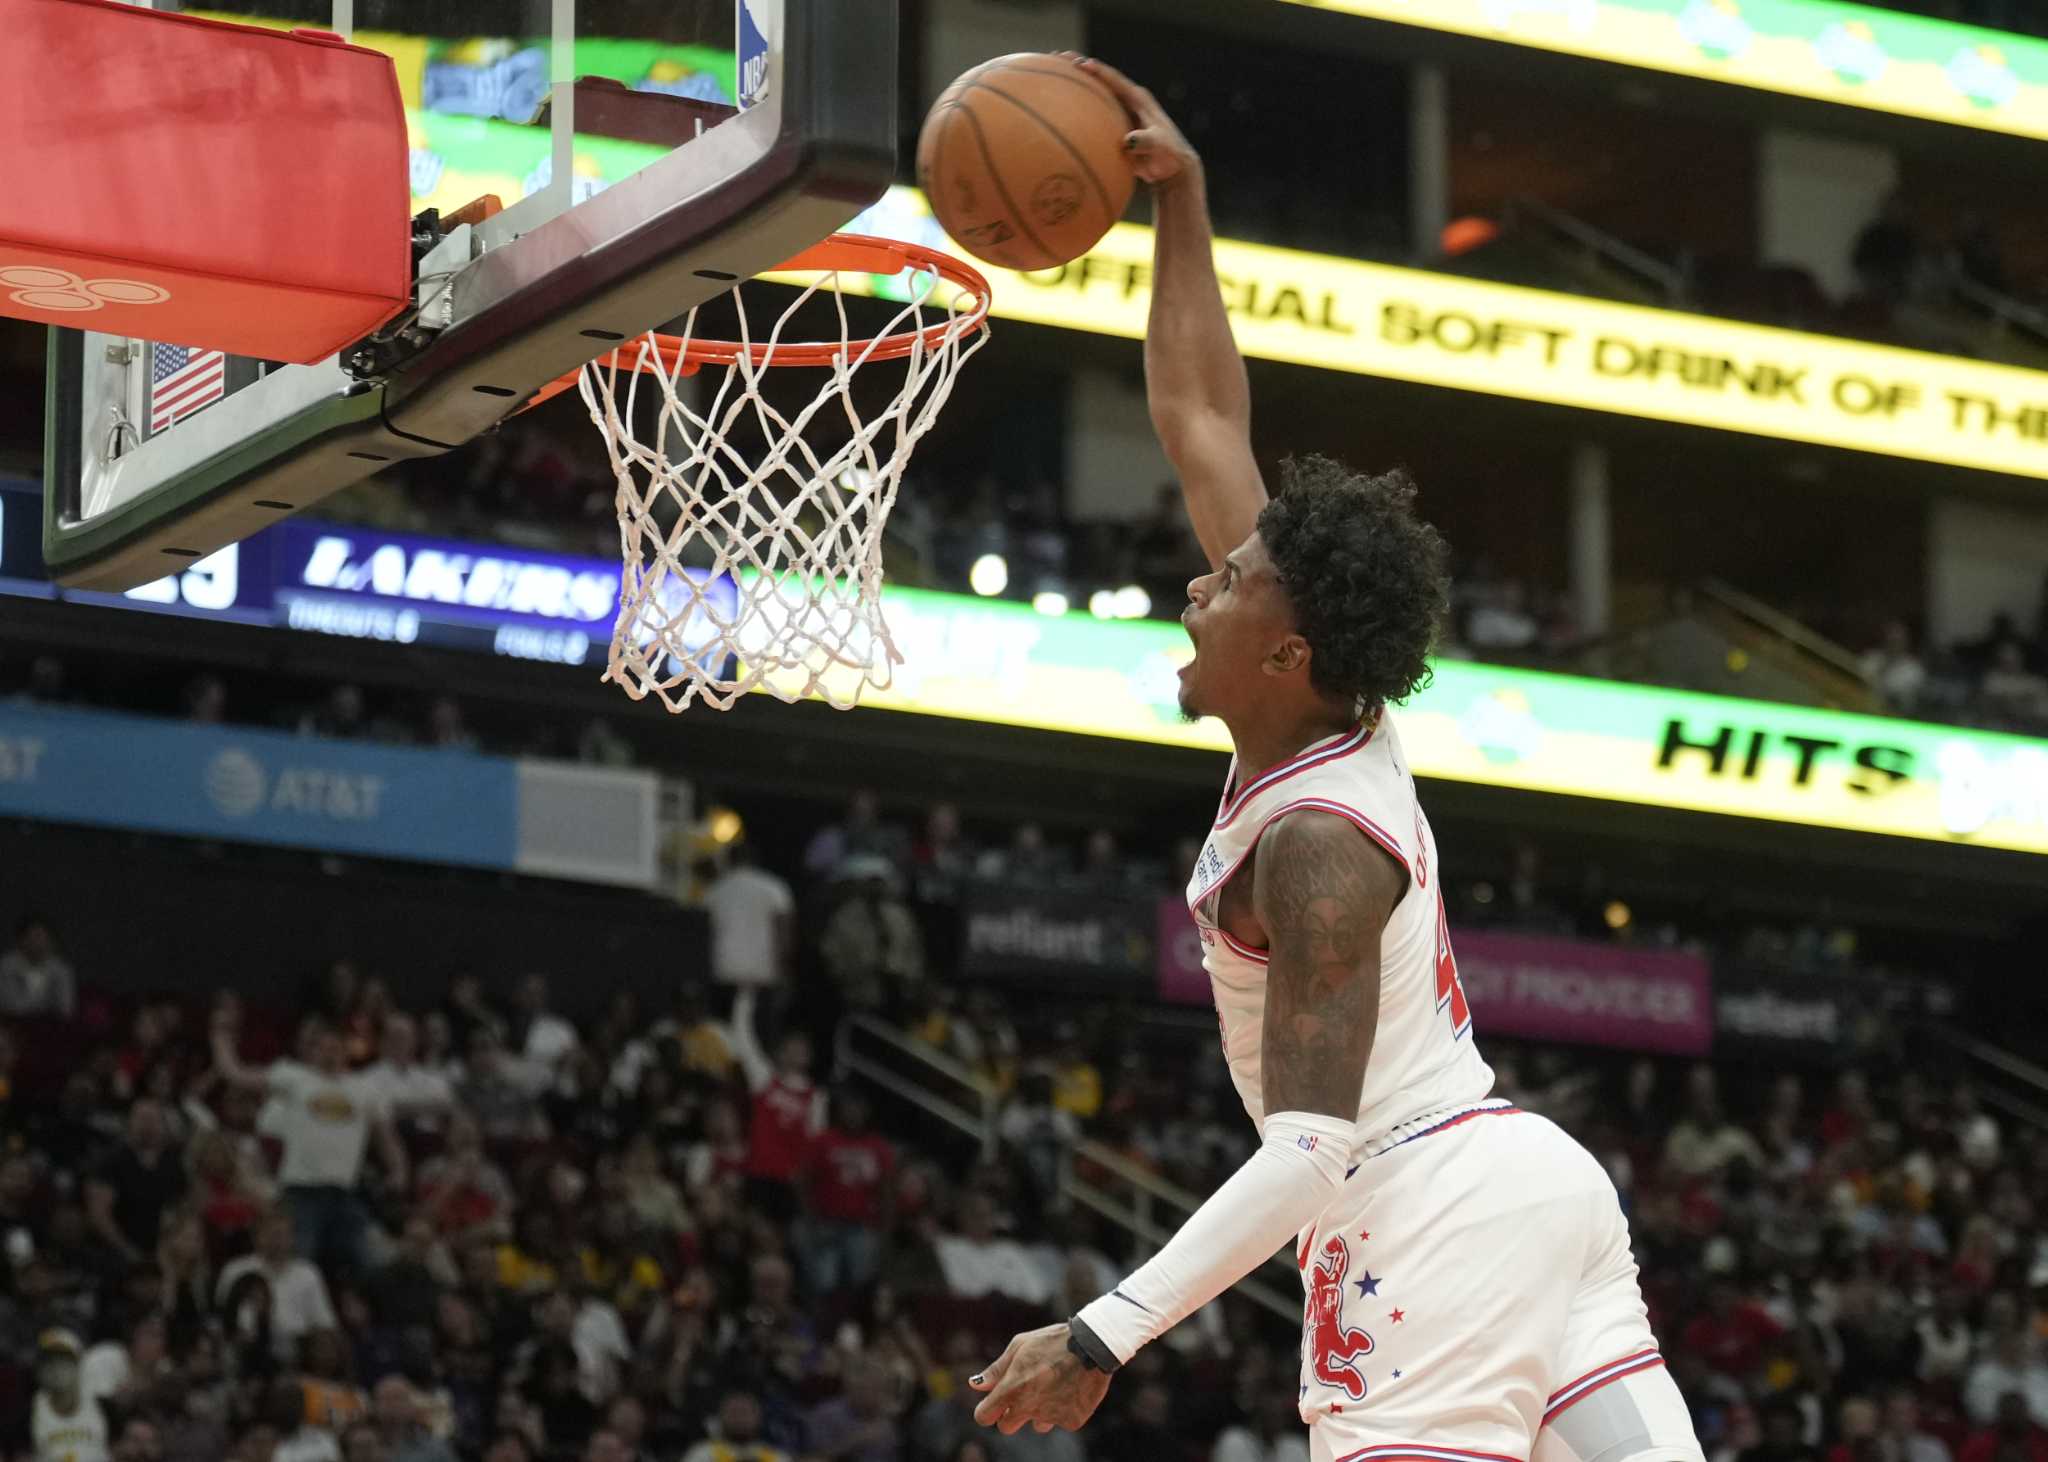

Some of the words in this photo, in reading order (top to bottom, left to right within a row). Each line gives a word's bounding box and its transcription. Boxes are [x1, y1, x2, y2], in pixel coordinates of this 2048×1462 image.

[1380, 302, 1574, 366] SOFT
[1594, 338, 1807, 405] DRINK
[1832, 372, 1921, 416] OF
[269, 767, 384, 822] AT&T
[1656, 718, 1915, 796] HITS
